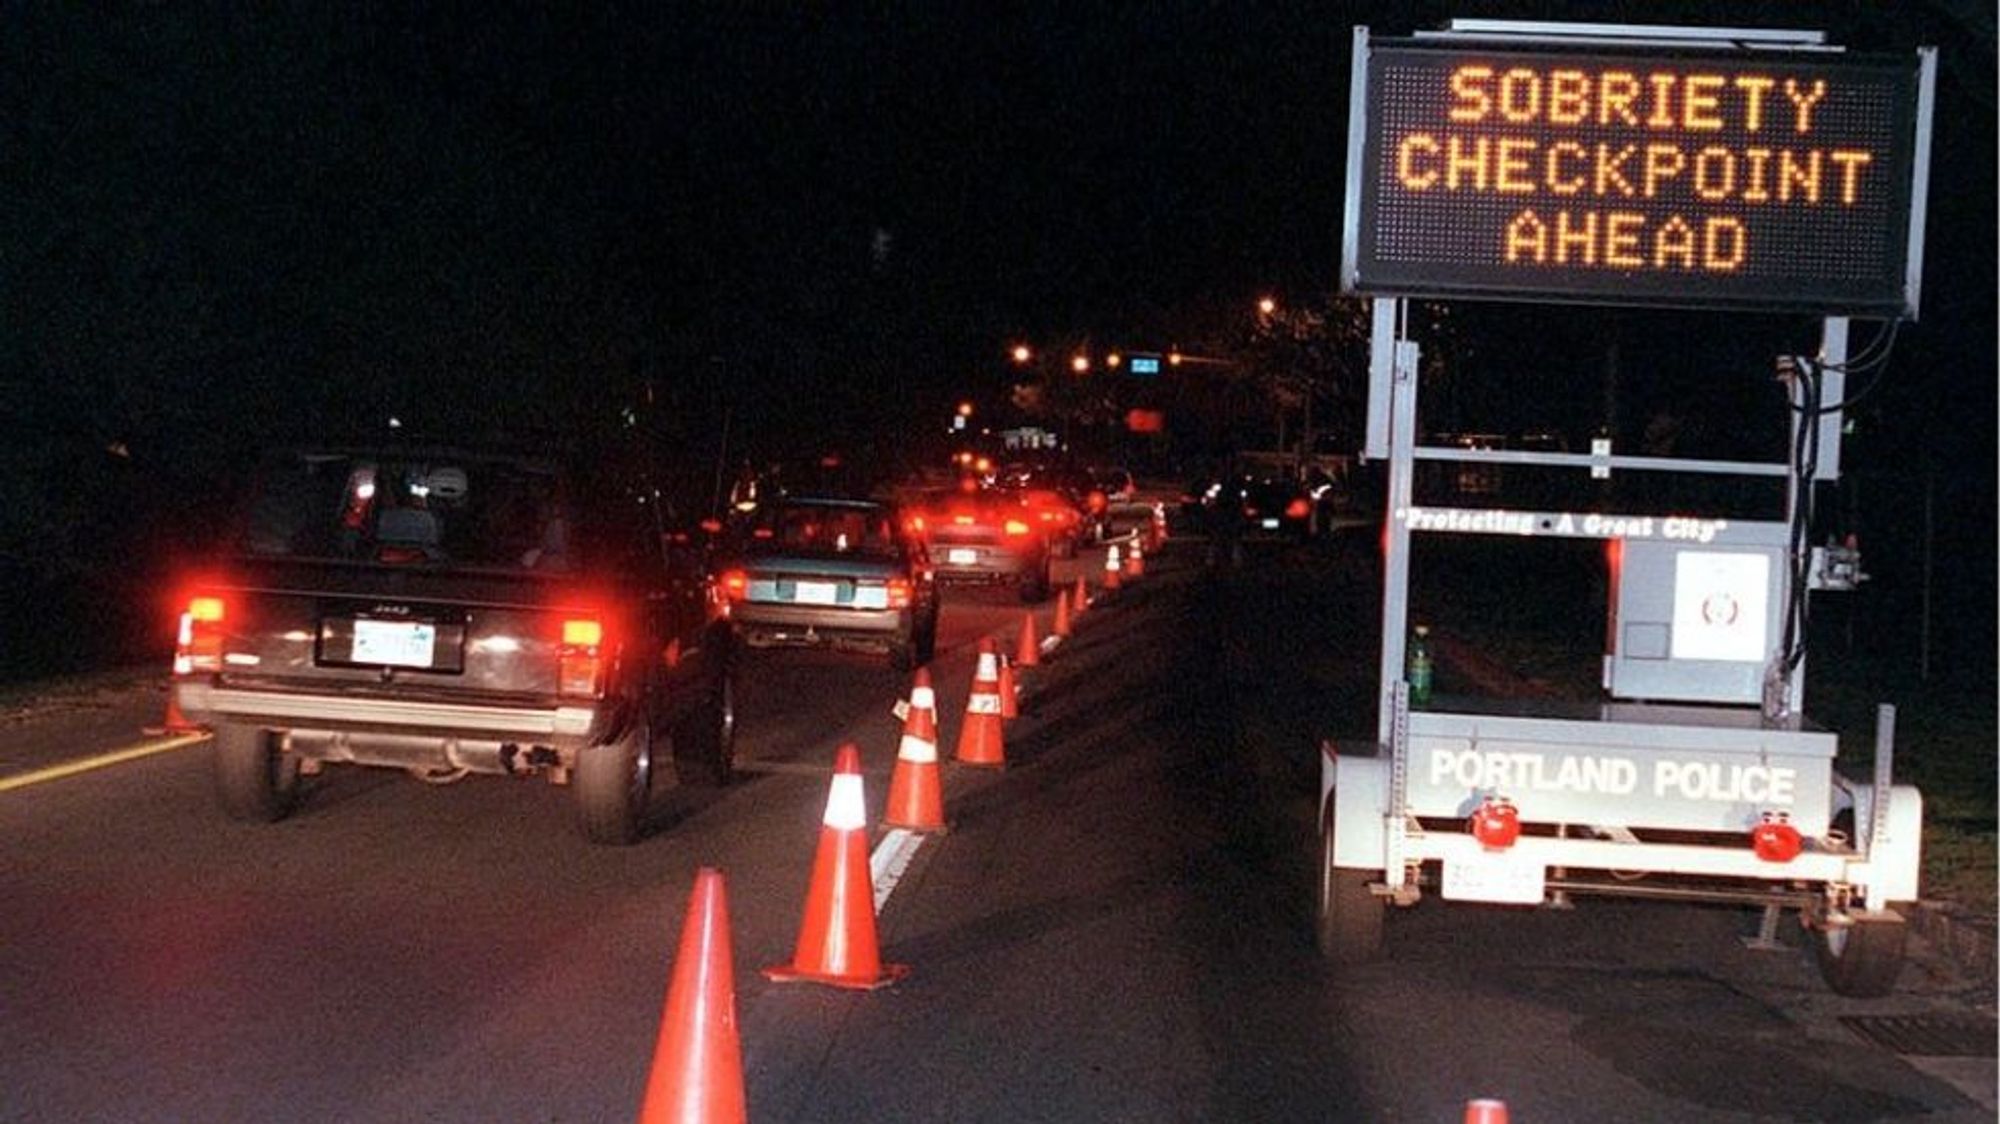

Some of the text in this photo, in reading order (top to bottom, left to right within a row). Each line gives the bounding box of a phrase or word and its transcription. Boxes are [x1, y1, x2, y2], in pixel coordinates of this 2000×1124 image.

[1450, 66, 1825, 132] SOBRIETY
[1399, 133, 1872, 203] CHECKPOINT
[1507, 210, 1749, 271] AHEAD
[1556, 513, 1575, 535] A
[1583, 514, 1653, 537] Great
[1430, 750, 1797, 803] PORTLAND POLICE
